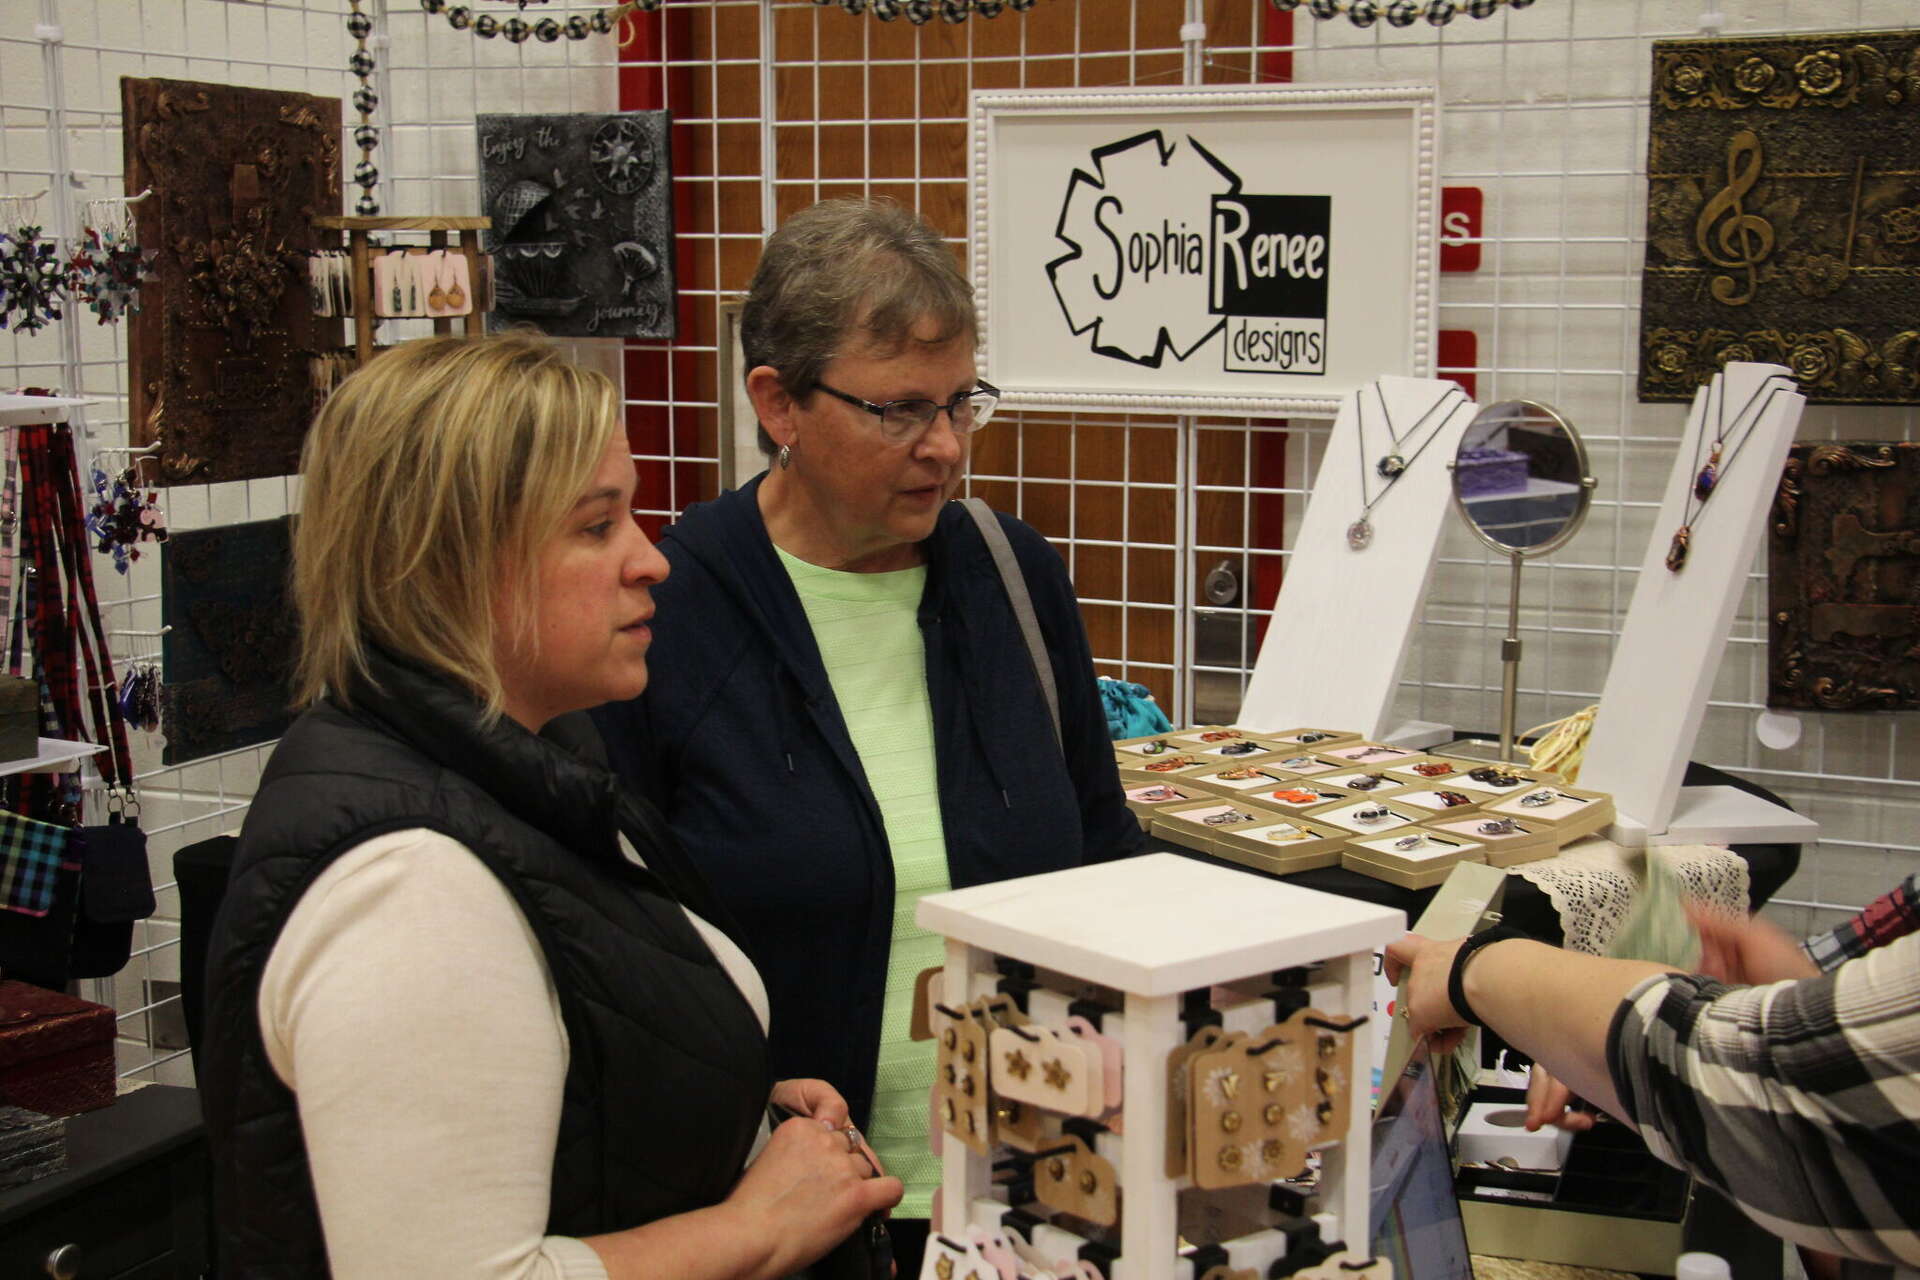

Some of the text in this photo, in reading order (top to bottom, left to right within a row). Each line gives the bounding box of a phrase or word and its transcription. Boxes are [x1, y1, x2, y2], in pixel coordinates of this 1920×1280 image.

[482, 134, 525, 165] Enjoy
[1093, 195, 1325, 309] Sophia Renee
[586, 303, 659, 332] journey
[1233, 319, 1320, 370] designs
